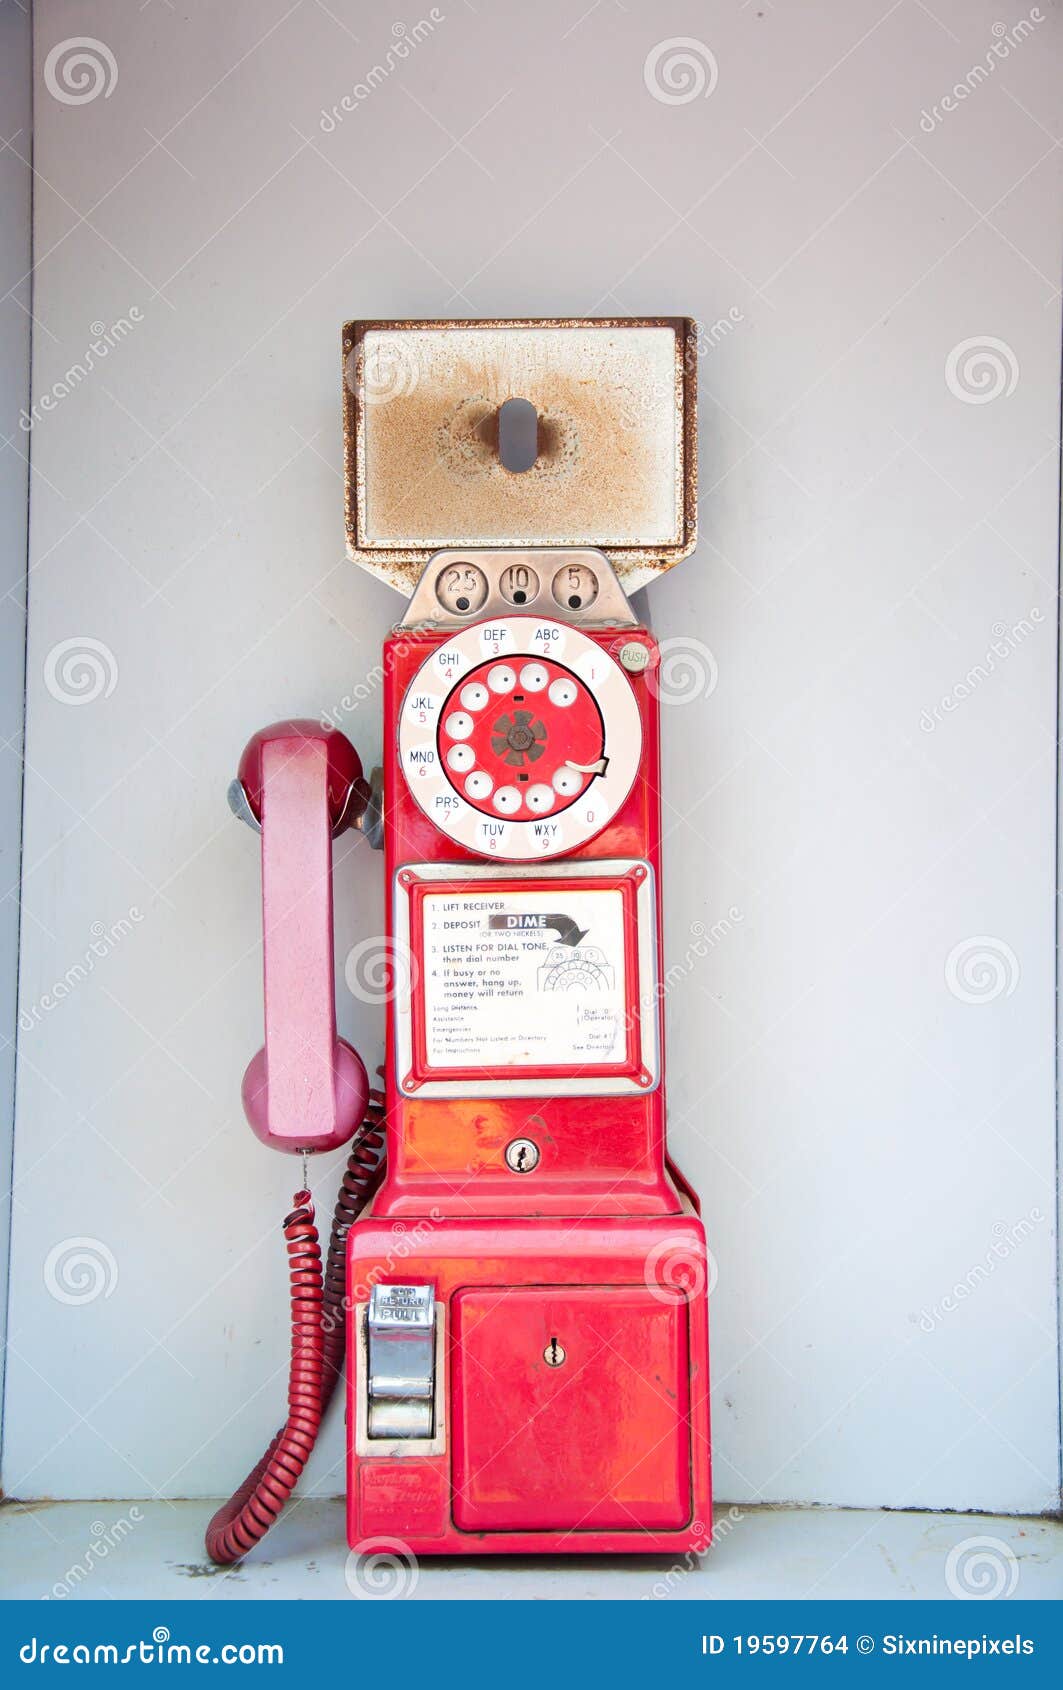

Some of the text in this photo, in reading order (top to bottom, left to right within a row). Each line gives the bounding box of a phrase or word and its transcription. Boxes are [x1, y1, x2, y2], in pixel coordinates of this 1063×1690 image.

[447, 570, 476, 592] 25
[508, 568, 530, 589] 10
[568, 568, 580, 590] 5
[484, 630, 506, 640] DEF
[536, 628, 559, 640] ABC
[492, 643, 500, 654] 3
[544, 642, 550, 654] 2
[439, 654, 460, 665] GHI
[622, 650, 648, 664] PUSH
[444, 668, 452, 678] 4
[412, 698, 434, 709] JKL
[420, 712, 426, 722] 5
[410, 752, 434, 763] MNO
[420, 766, 426, 776] 6
[436, 797, 459, 808] PRS
[444, 811, 451, 822] 7
[587, 812, 594, 822] 0
[482, 824, 504, 836] TUV
[534, 825, 558, 836] WXY
[490, 839, 496, 850] 8
[542, 839, 549, 850] 9
[443, 904, 460, 912] LIFT
[464, 902, 505, 910] RECEIVER
[444, 921, 480, 930] DEPOSIT
[507, 916, 546, 928] DIME
[443, 944, 472, 952] LISTEN
[476, 944, 494, 952] FOR
[522, 942, 549, 951] TONE,
[486, 954, 519, 962] number
[454, 970, 474, 978] busy
[381, 1308, 420, 1321] PULL
